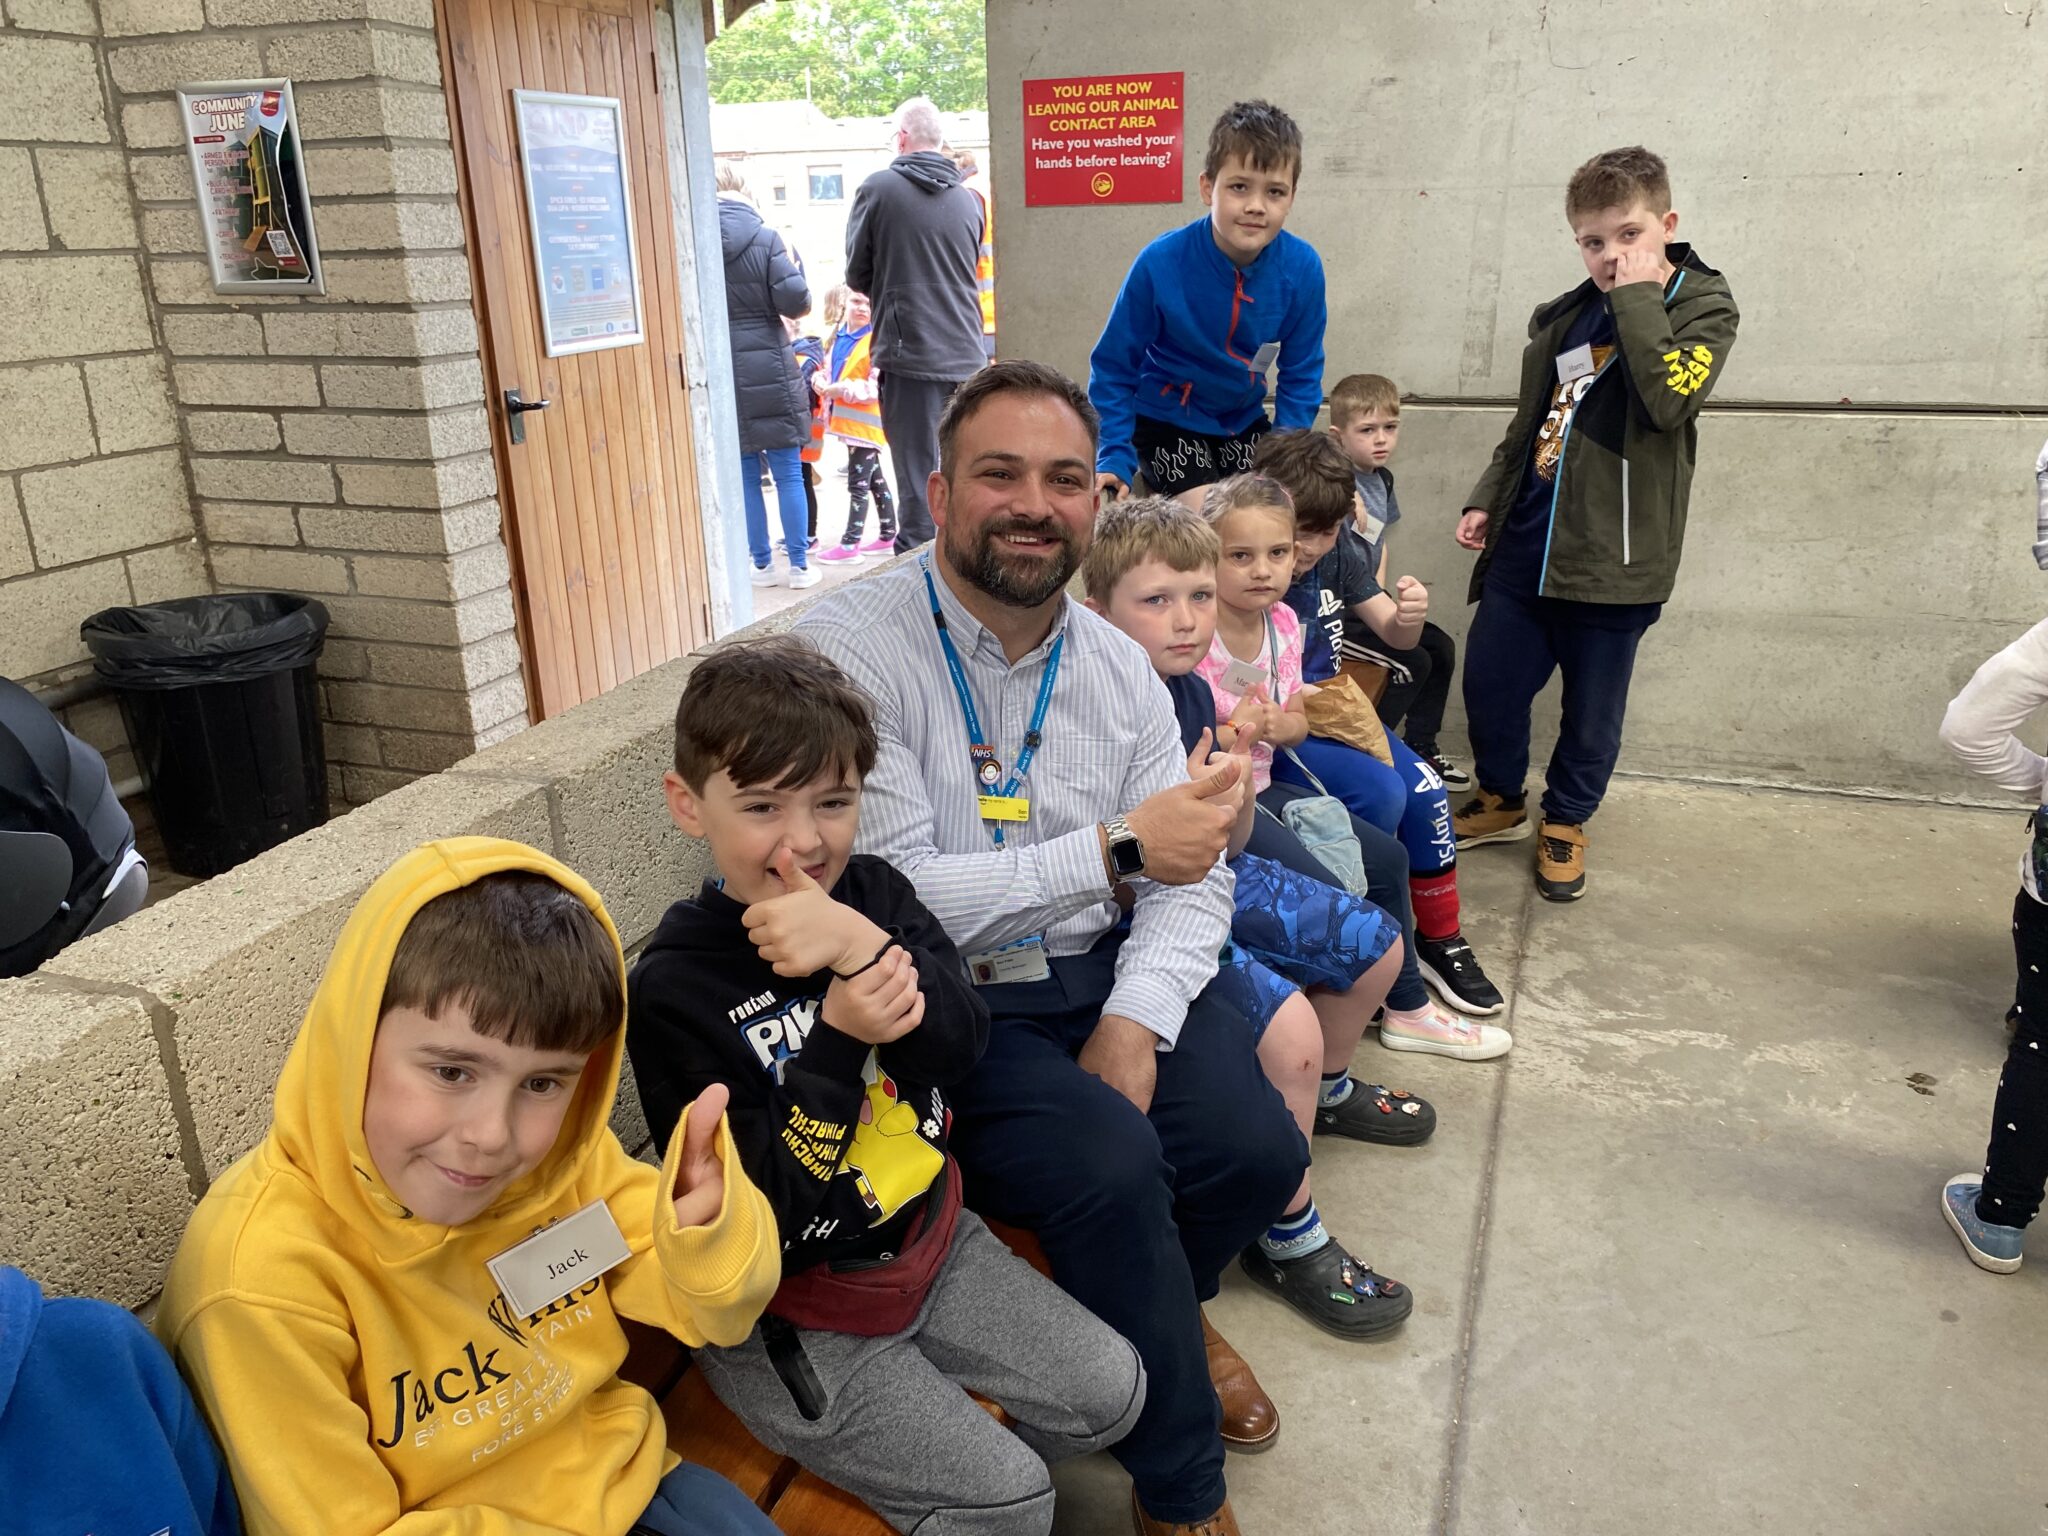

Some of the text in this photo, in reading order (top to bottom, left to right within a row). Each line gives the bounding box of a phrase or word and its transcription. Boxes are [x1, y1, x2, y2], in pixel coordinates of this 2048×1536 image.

[1052, 81, 1152, 98] YOU ARE NOW
[192, 94, 258, 115] COMMUNITY
[1028, 97, 1178, 116] LEAVING OUR ANIMAL
[210, 111, 245, 132] JUNE
[1049, 115, 1157, 132] CONTACT AREA
[1031, 133, 1176, 152] Have you washed your
[1035, 152, 1172, 169] hands before leaving?
[973, 749, 991, 758] NHS
[546, 1247, 590, 1280] Jack
[377, 1341, 511, 1448] Jack
[453, 1362, 538, 1427] GREAT
[471, 1423, 525, 1463] FORE
